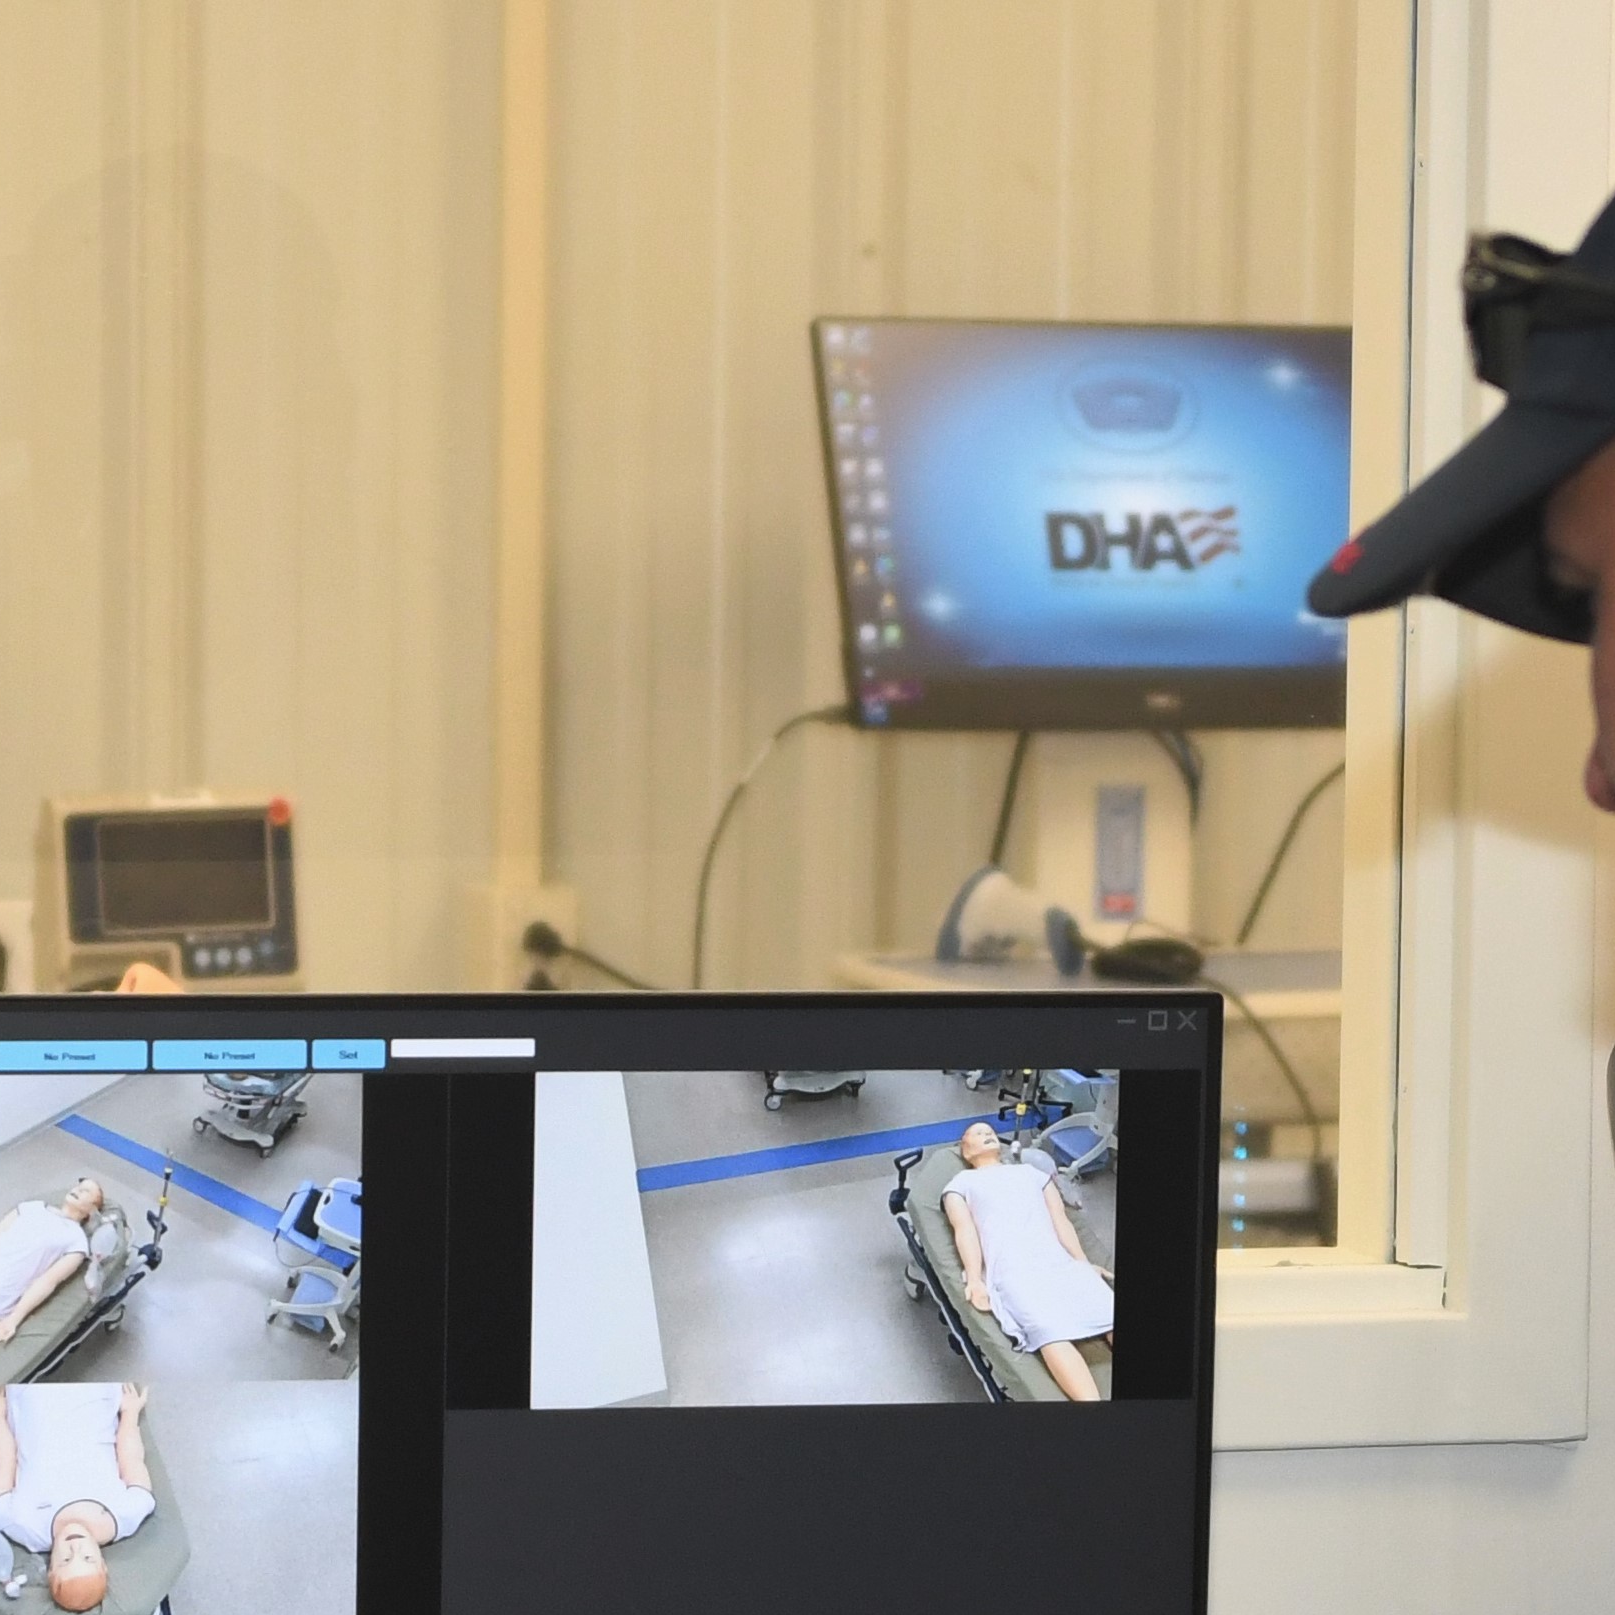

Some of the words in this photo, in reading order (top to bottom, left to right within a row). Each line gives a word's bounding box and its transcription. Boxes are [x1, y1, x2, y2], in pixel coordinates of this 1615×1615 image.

[1045, 511, 1194, 571] DHA
[43, 1052, 59, 1062] No
[61, 1052, 96, 1062] Preset
[203, 1051, 219, 1061] No
[221, 1051, 255, 1061] Preset
